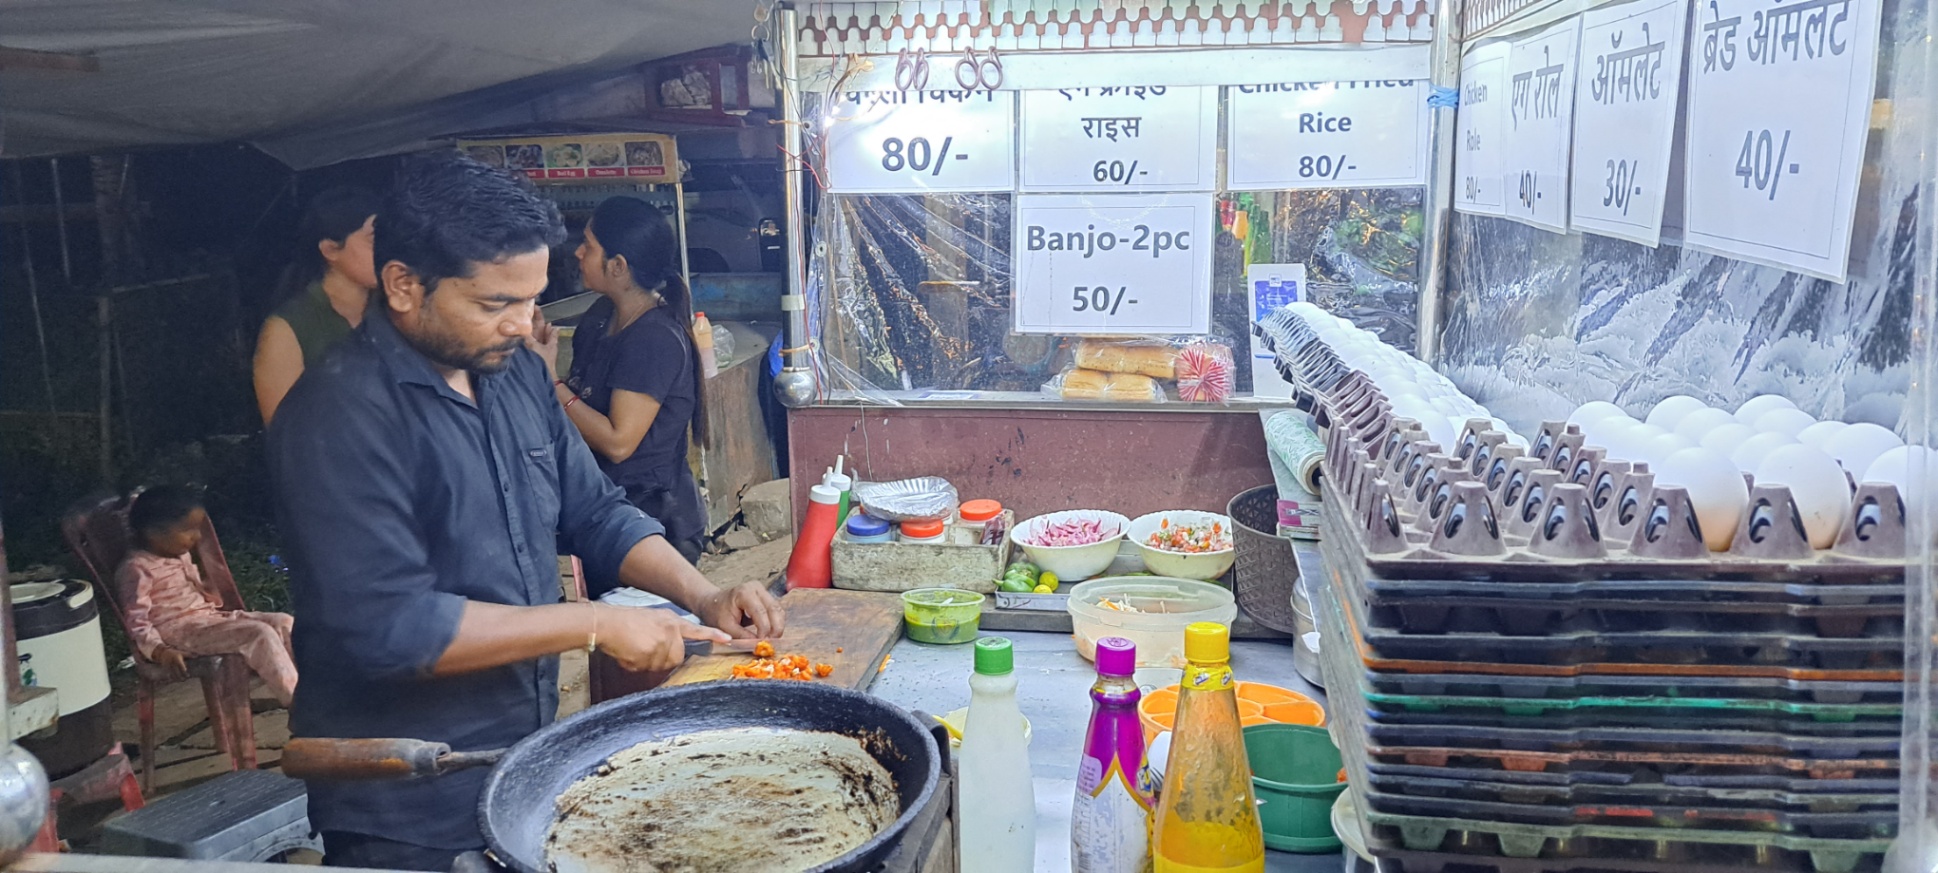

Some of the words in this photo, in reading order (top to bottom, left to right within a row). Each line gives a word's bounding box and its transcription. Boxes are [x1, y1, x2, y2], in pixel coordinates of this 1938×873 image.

[1591, 21, 1666, 105] ऑमलेट
[1464, 80, 1488, 107] Chicken
[1511, 70, 1533, 131] एग
[1534, 44, 1564, 120] रोल
[1081, 116, 1142, 143] राइस
[1299, 111, 1352, 133] Rice
[1466, 129, 1481, 152] Role
[881, 136, 968, 176] 80/-
[1298, 154, 1357, 180] 80/-
[1735, 129, 1800, 201] 40/-
[1093, 160, 1148, 185] 60/-
[1465, 176, 1481, 204] 80/-
[1519, 169, 1542, 215] 40/-
[1603, 159, 1641, 216] 30/-
[1027, 224, 1190, 259] Banjo-2pc
[1072, 286, 1138, 315] 50/-
